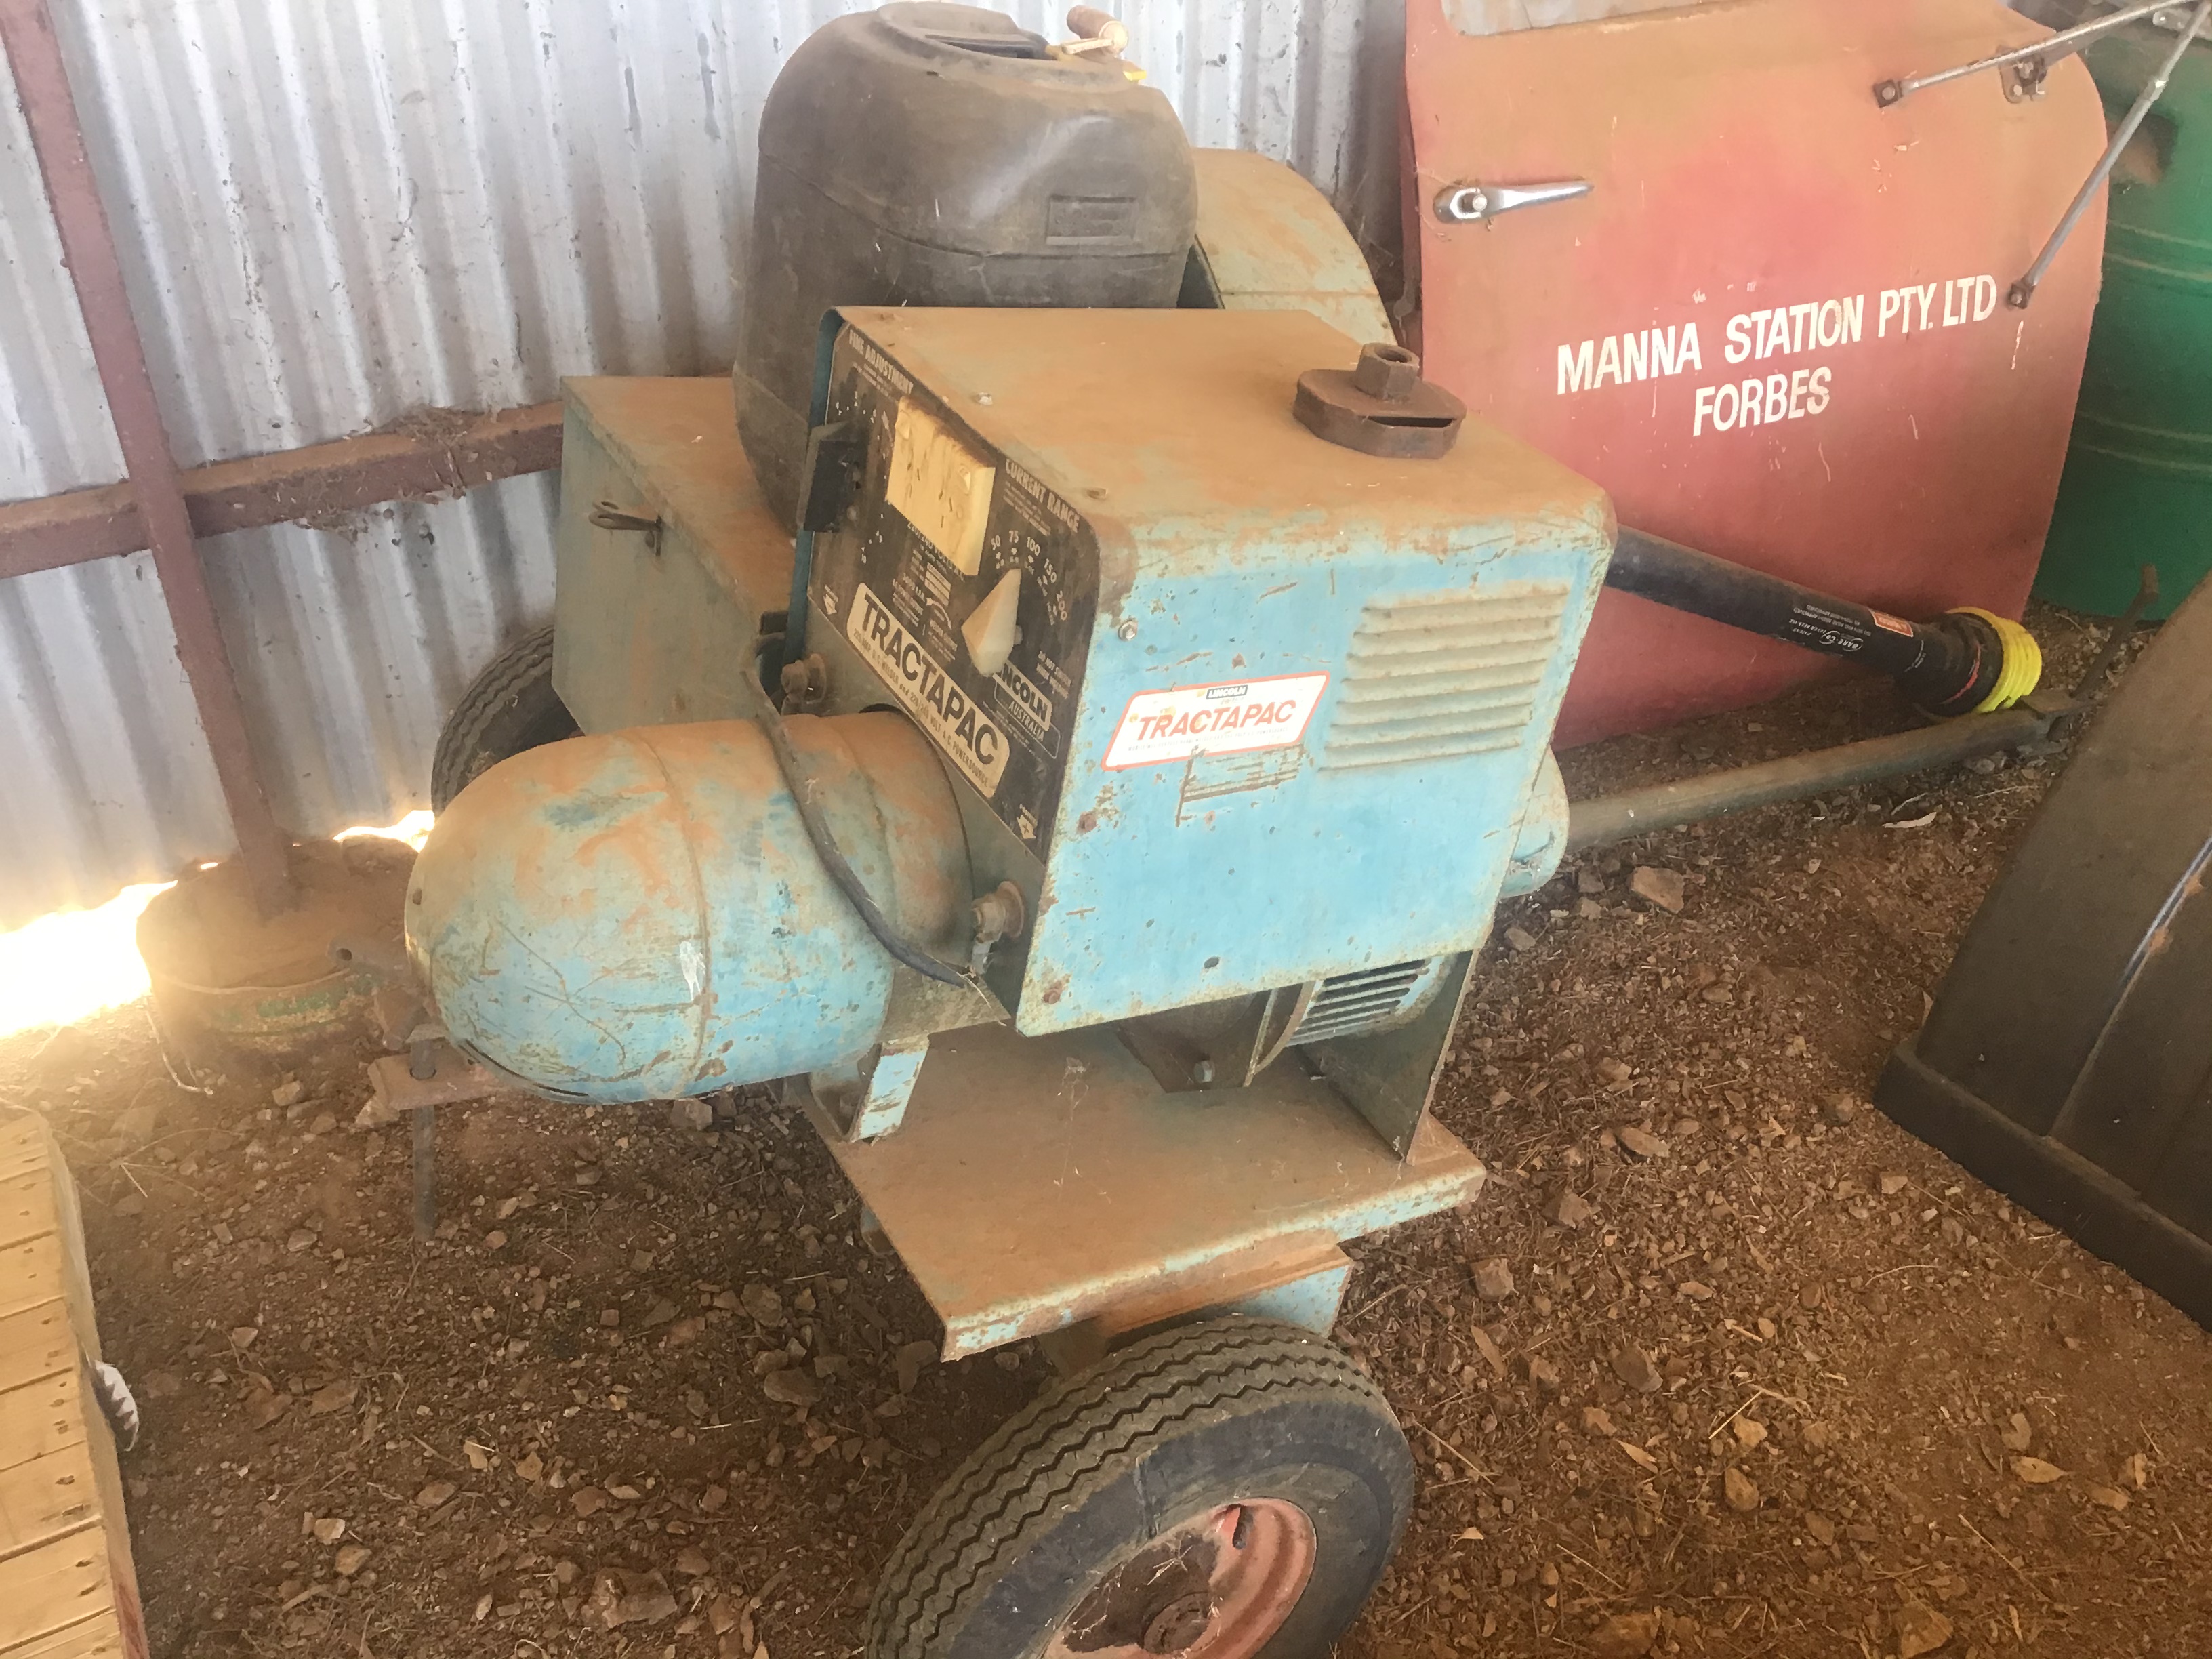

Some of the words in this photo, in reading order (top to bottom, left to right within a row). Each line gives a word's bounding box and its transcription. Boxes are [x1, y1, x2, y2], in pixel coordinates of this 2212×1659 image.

[1557, 322, 1702, 394] MANNA
[1725, 294, 1864, 365] STATION
[1942, 274, 1997, 327] LTD
[849, 329, 864, 355] FINE
[865, 345, 914, 395] ADJUSTMENT
[1694, 367, 1832, 436] FORBES
[1006, 459, 1046, 503] CURRENT
[1047, 492, 1080, 533] RANGE
[991, 535, 1000, 550] 50
[1008, 530, 1019, 543] 75
[1027, 537, 1040, 556] 100
[1044, 558, 1057, 583] 150
[1056, 590, 1067, 621] 200
[860, 594, 998, 765] TRACTAPAC
[1208, 687, 1246, 698] LINCOLN
[1008, 701, 1045, 741] AUSTRALIA
[1137, 700, 1296, 741] TRACTAPAC
[953, 741, 987, 787] POWERSOURCE
